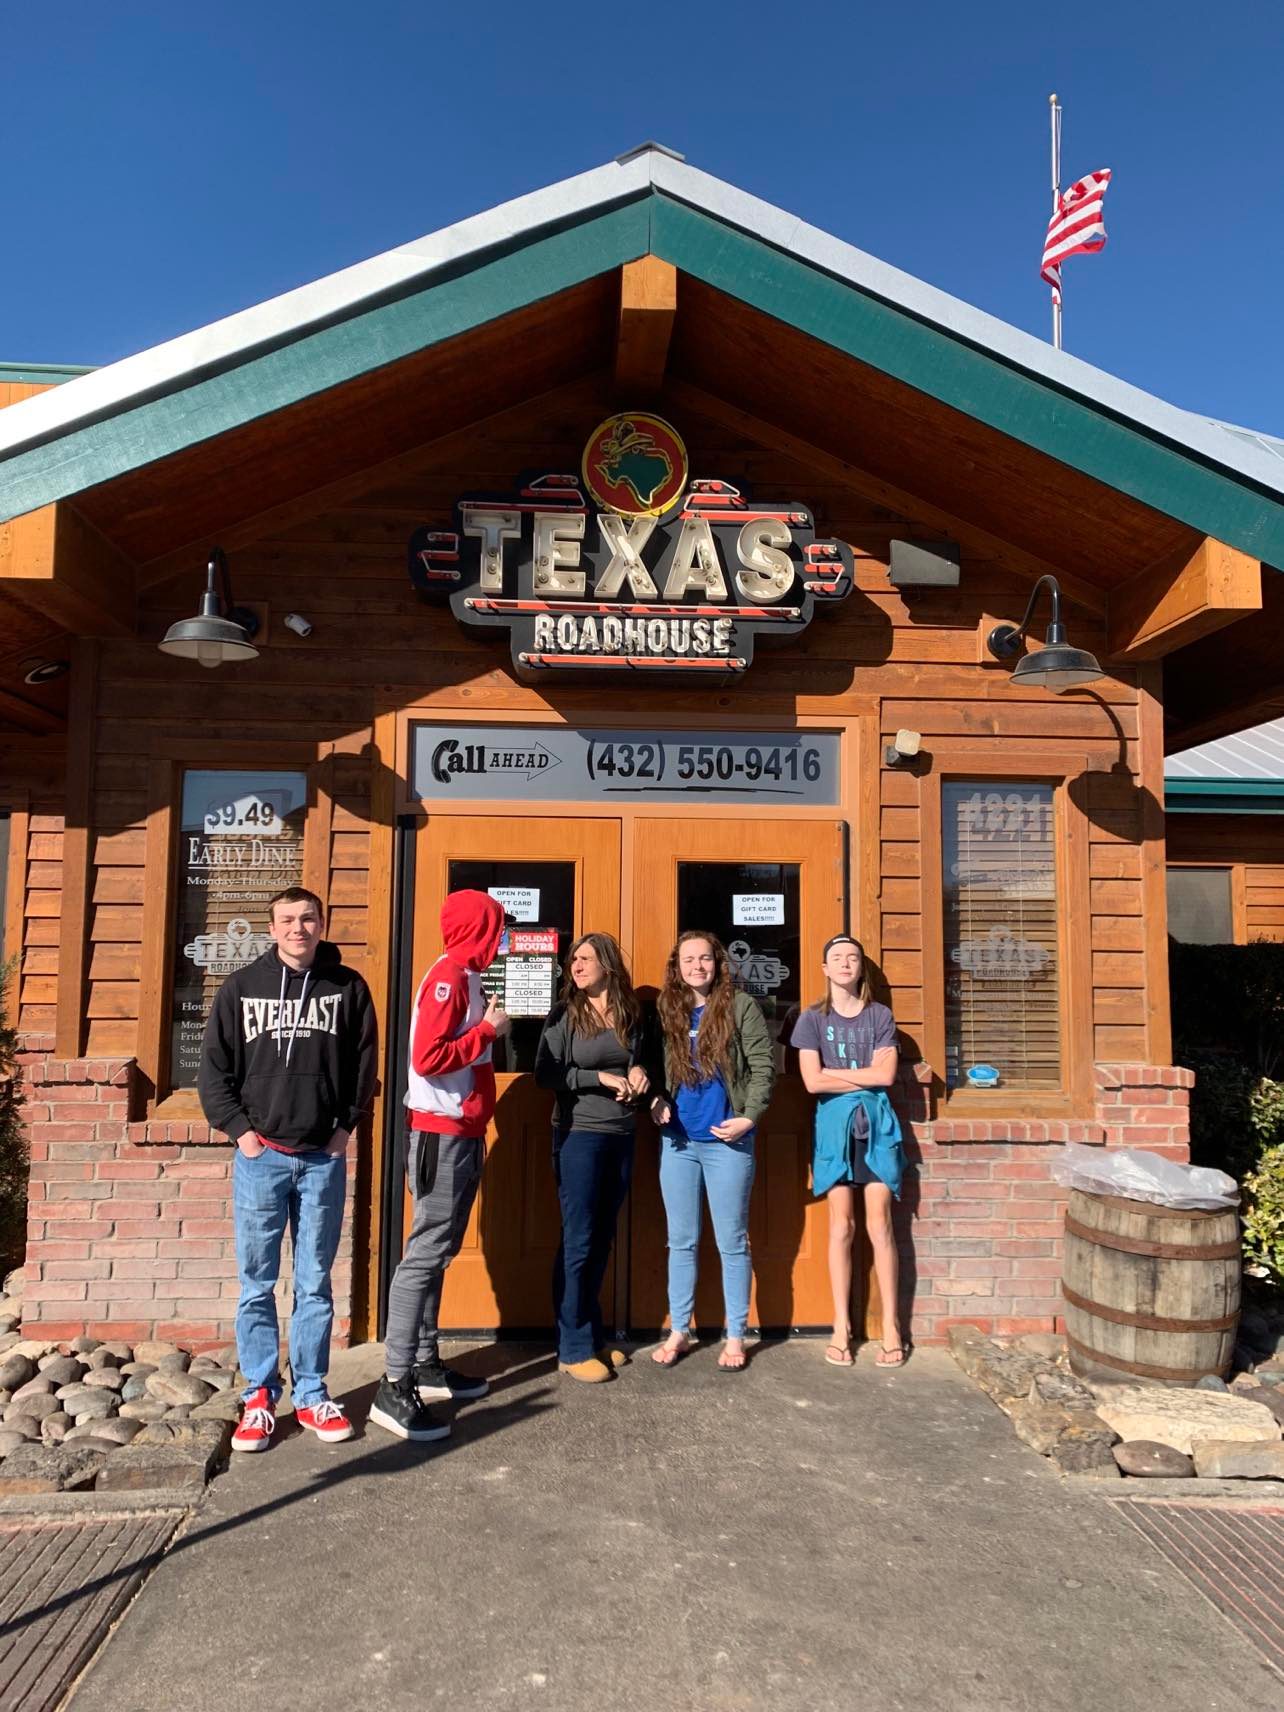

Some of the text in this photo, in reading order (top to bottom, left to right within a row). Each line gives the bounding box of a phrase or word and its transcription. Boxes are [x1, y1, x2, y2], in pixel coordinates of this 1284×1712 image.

[463, 509, 795, 603] TEXAS
[534, 613, 733, 654] ROADHOUSE
[431, 738, 822, 783] Call AHEAD (432) 550-9416
[206, 800, 275, 829] $9.49
[515, 934, 555, 943] HOLIDAY
[515, 942, 555, 952] HOURS
[240, 993, 343, 1044] EVERLAST
